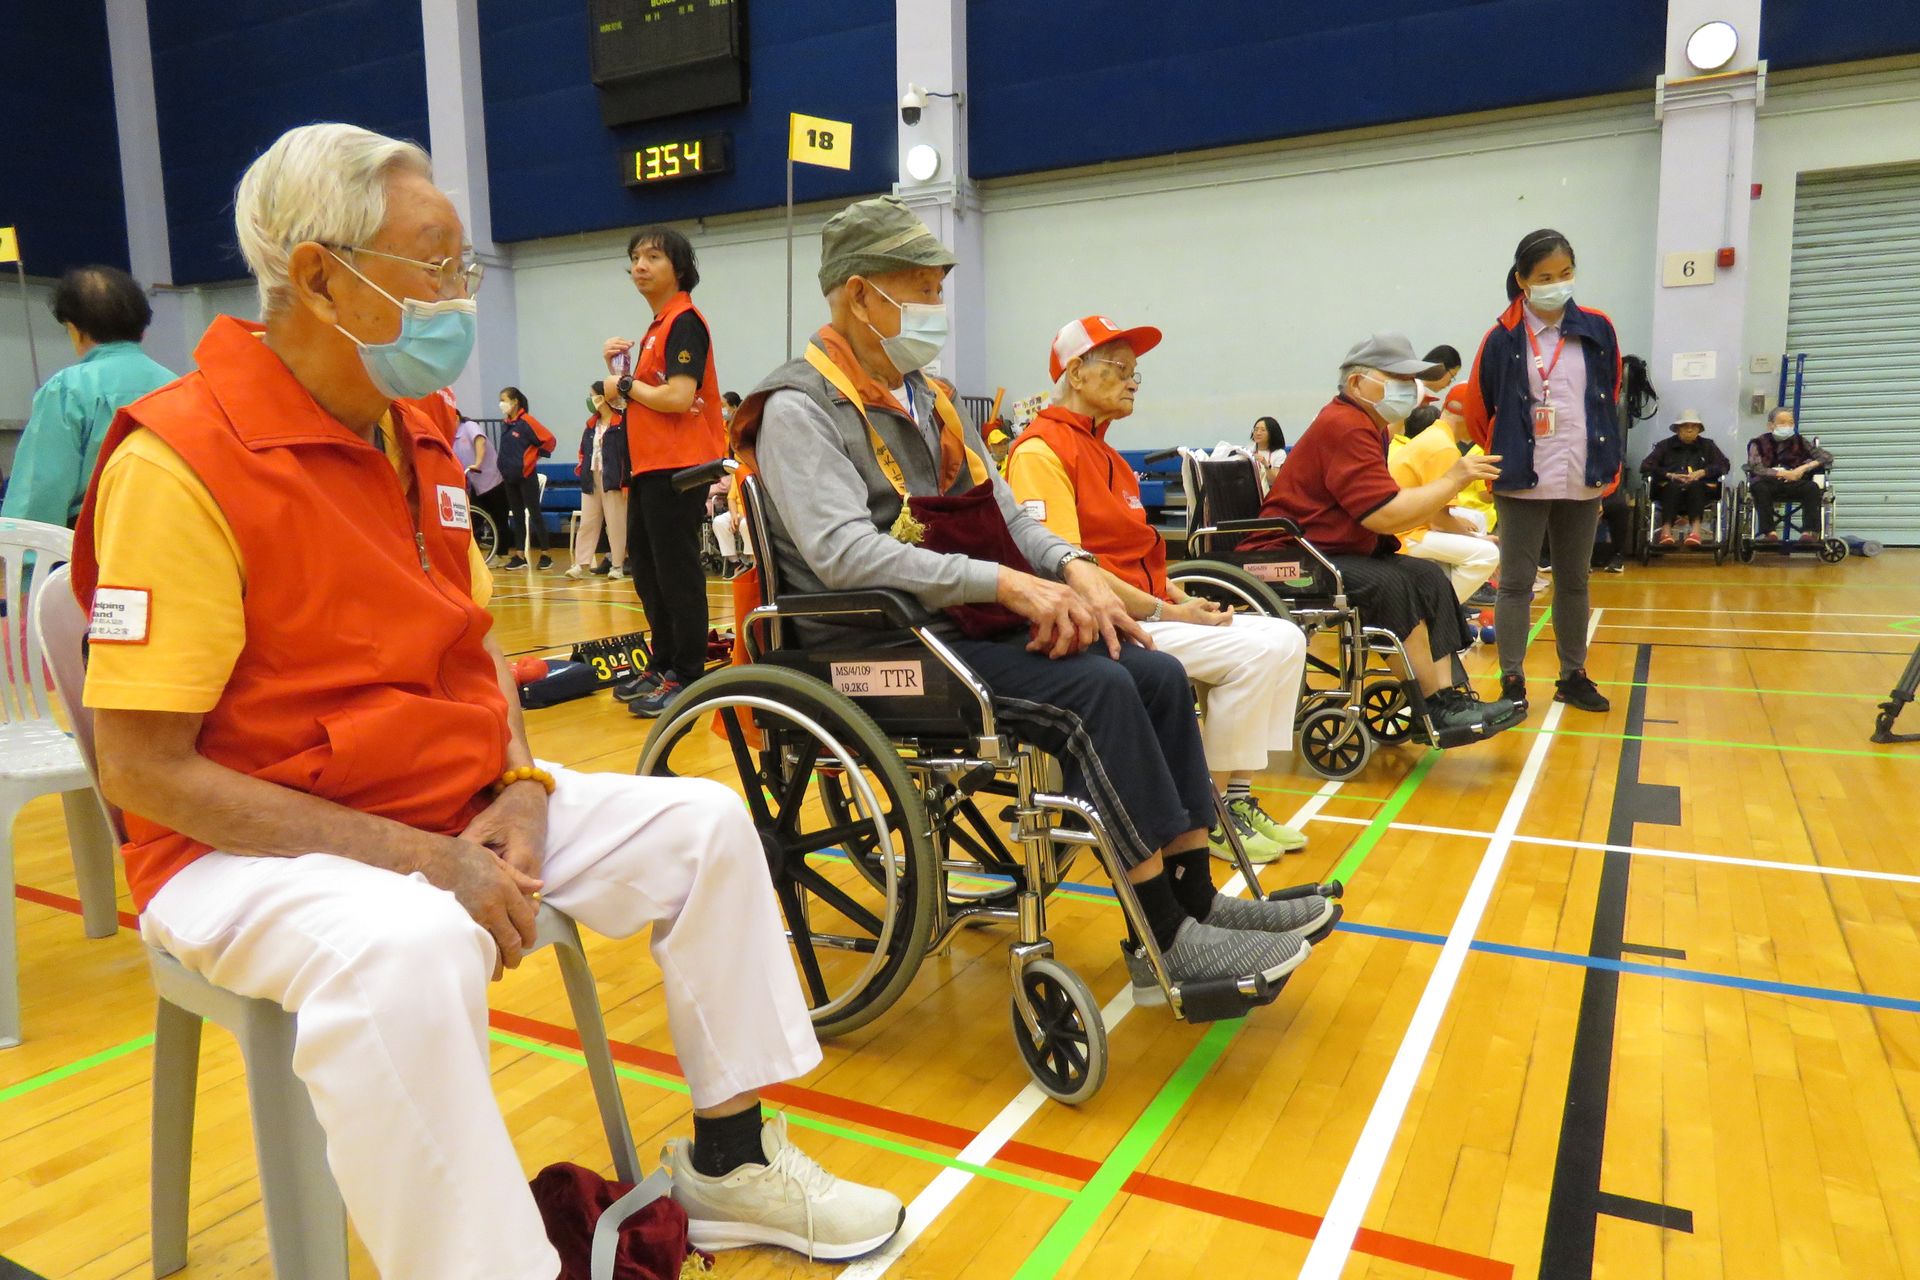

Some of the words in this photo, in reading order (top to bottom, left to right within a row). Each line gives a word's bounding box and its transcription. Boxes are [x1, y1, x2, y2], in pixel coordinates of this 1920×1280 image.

[806, 129, 834, 150] 18
[635, 141, 701, 181] 13:54
[1682, 260, 1696, 277] 6
[1275, 566, 1297, 578] TTR
[94, 602, 125, 612] elping
[591, 656, 612, 680] 3
[631, 648, 648, 671] 0
[835, 665, 871, 677] MS/4/109
[880, 668, 918, 688] TTR
[841, 682, 869, 693] 19.2KG
